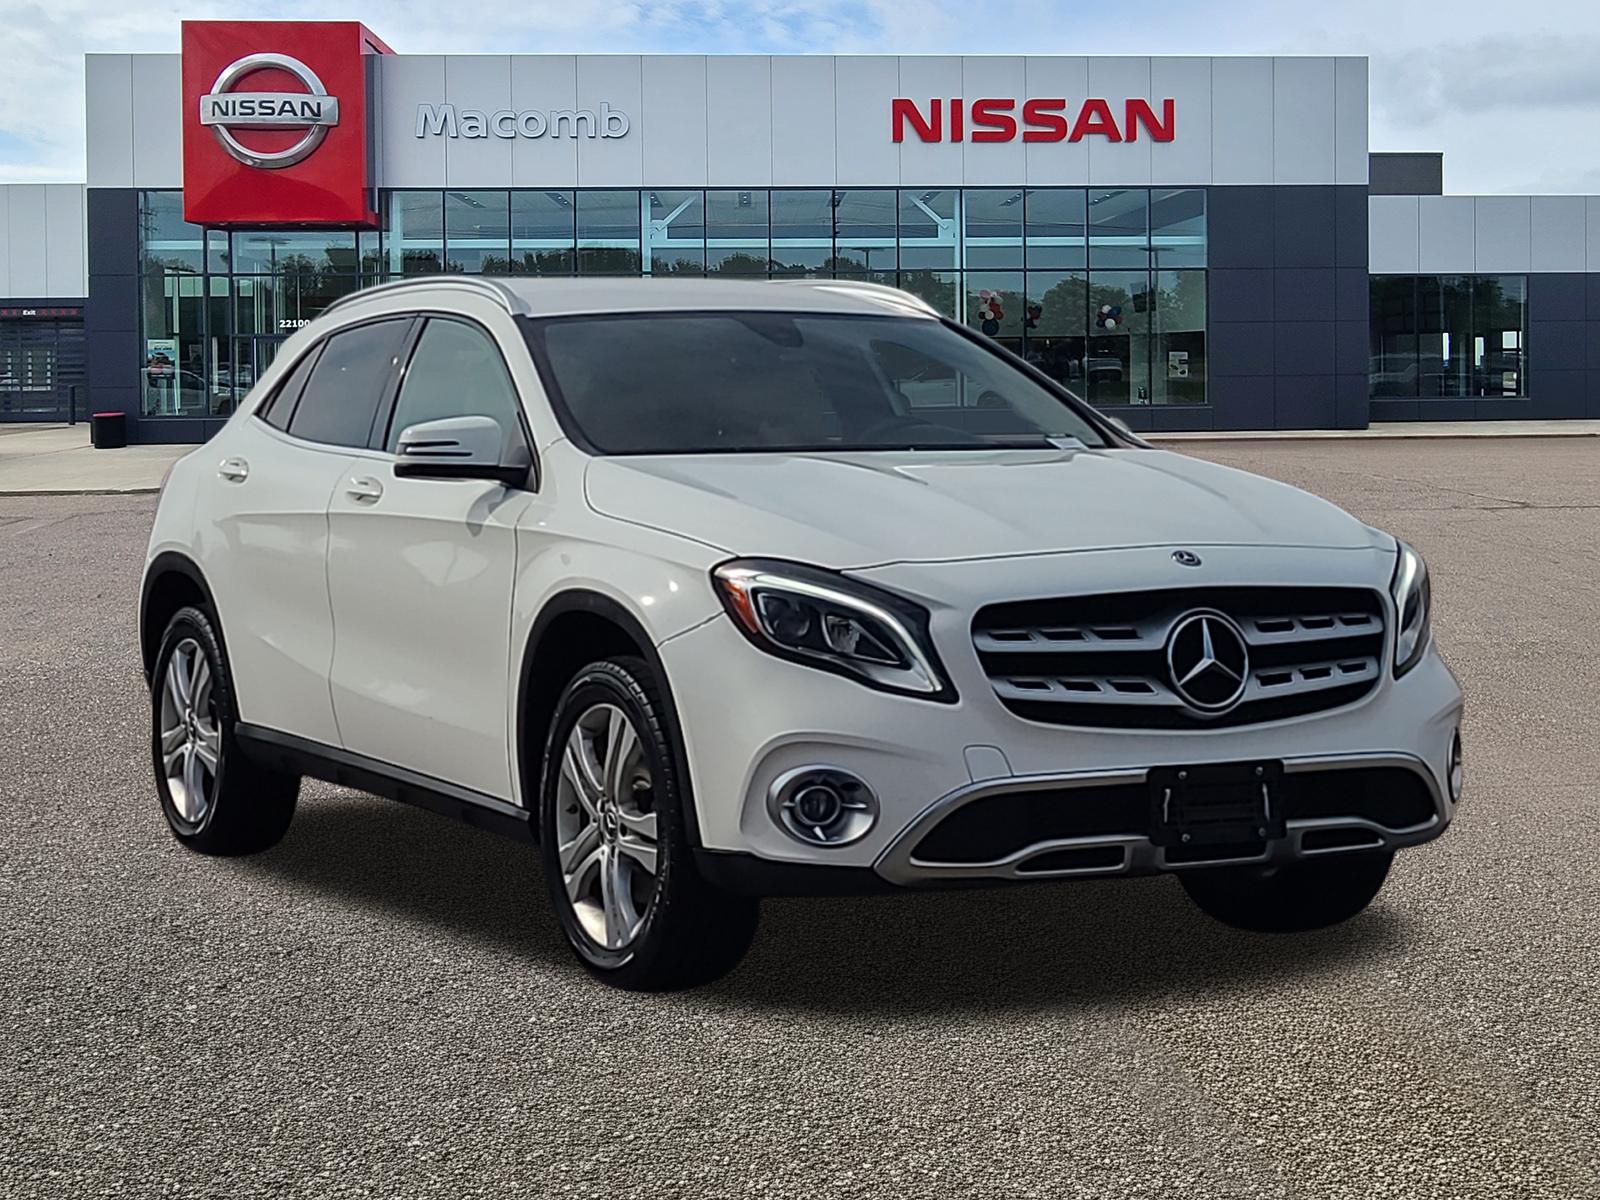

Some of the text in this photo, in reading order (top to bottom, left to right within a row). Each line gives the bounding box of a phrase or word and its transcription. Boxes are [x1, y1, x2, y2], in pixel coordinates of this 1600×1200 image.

[212, 100, 321, 117] NISSAN
[415, 102, 630, 139] Macomb
[892, 98, 1175, 143] NISSAN
